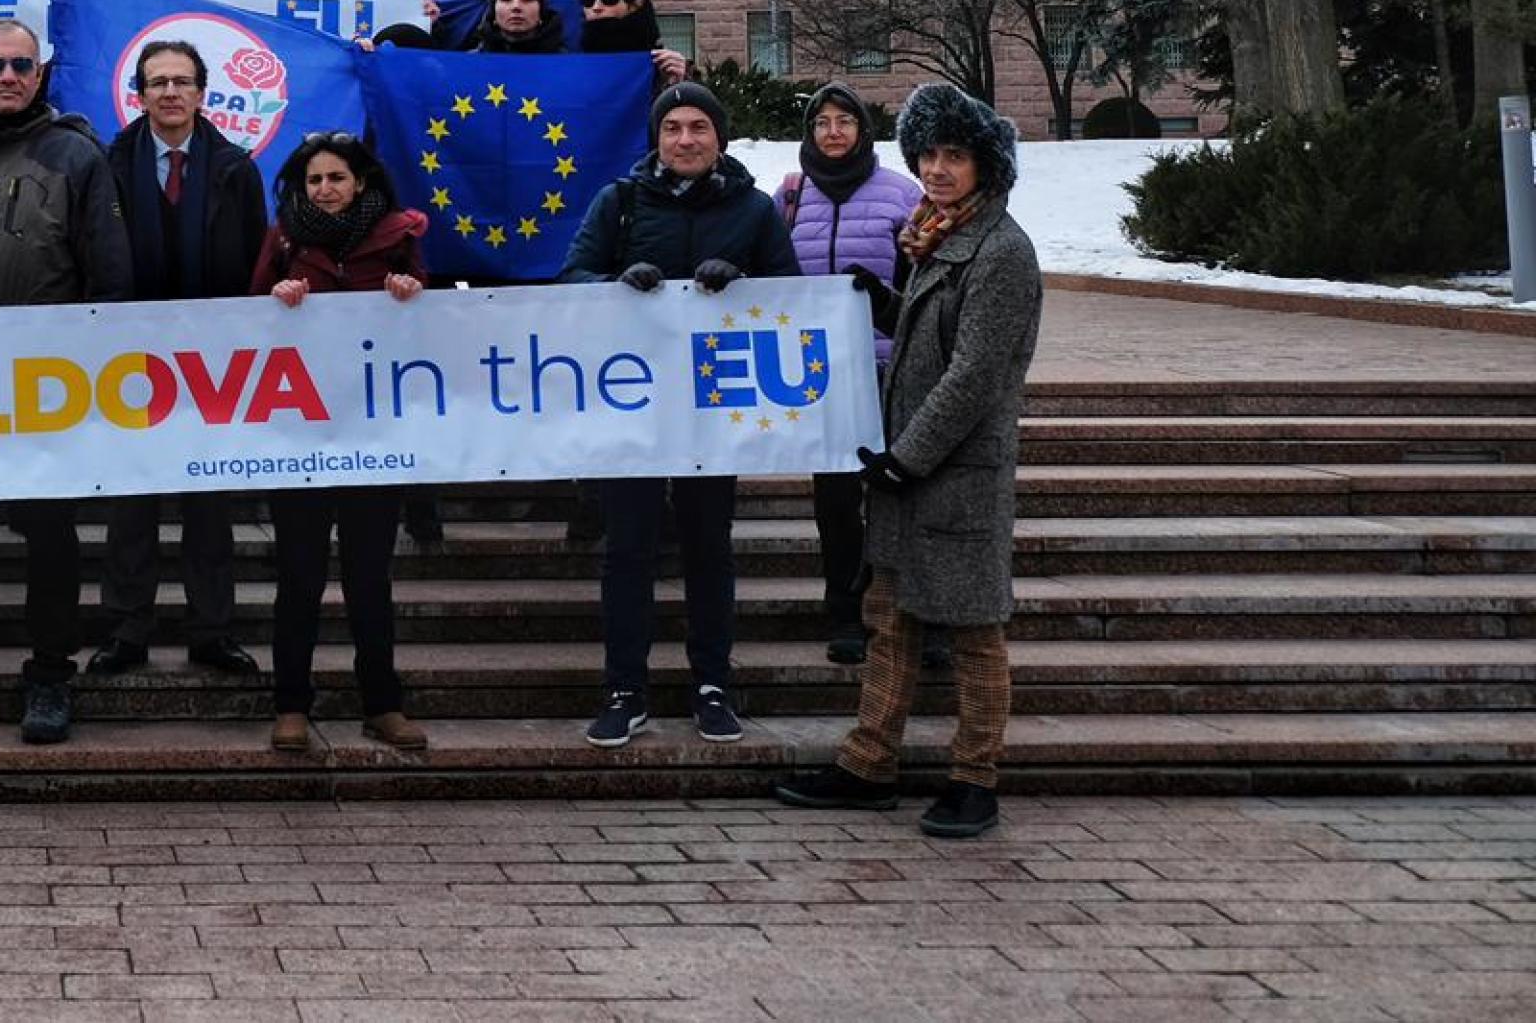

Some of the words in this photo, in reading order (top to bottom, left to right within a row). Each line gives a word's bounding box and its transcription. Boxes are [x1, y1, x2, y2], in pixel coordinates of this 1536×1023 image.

[362, 340, 446, 420] in
[480, 334, 654, 415] the
[691, 328, 830, 410] EU
[186, 450, 416, 478] europaradicale.eu
